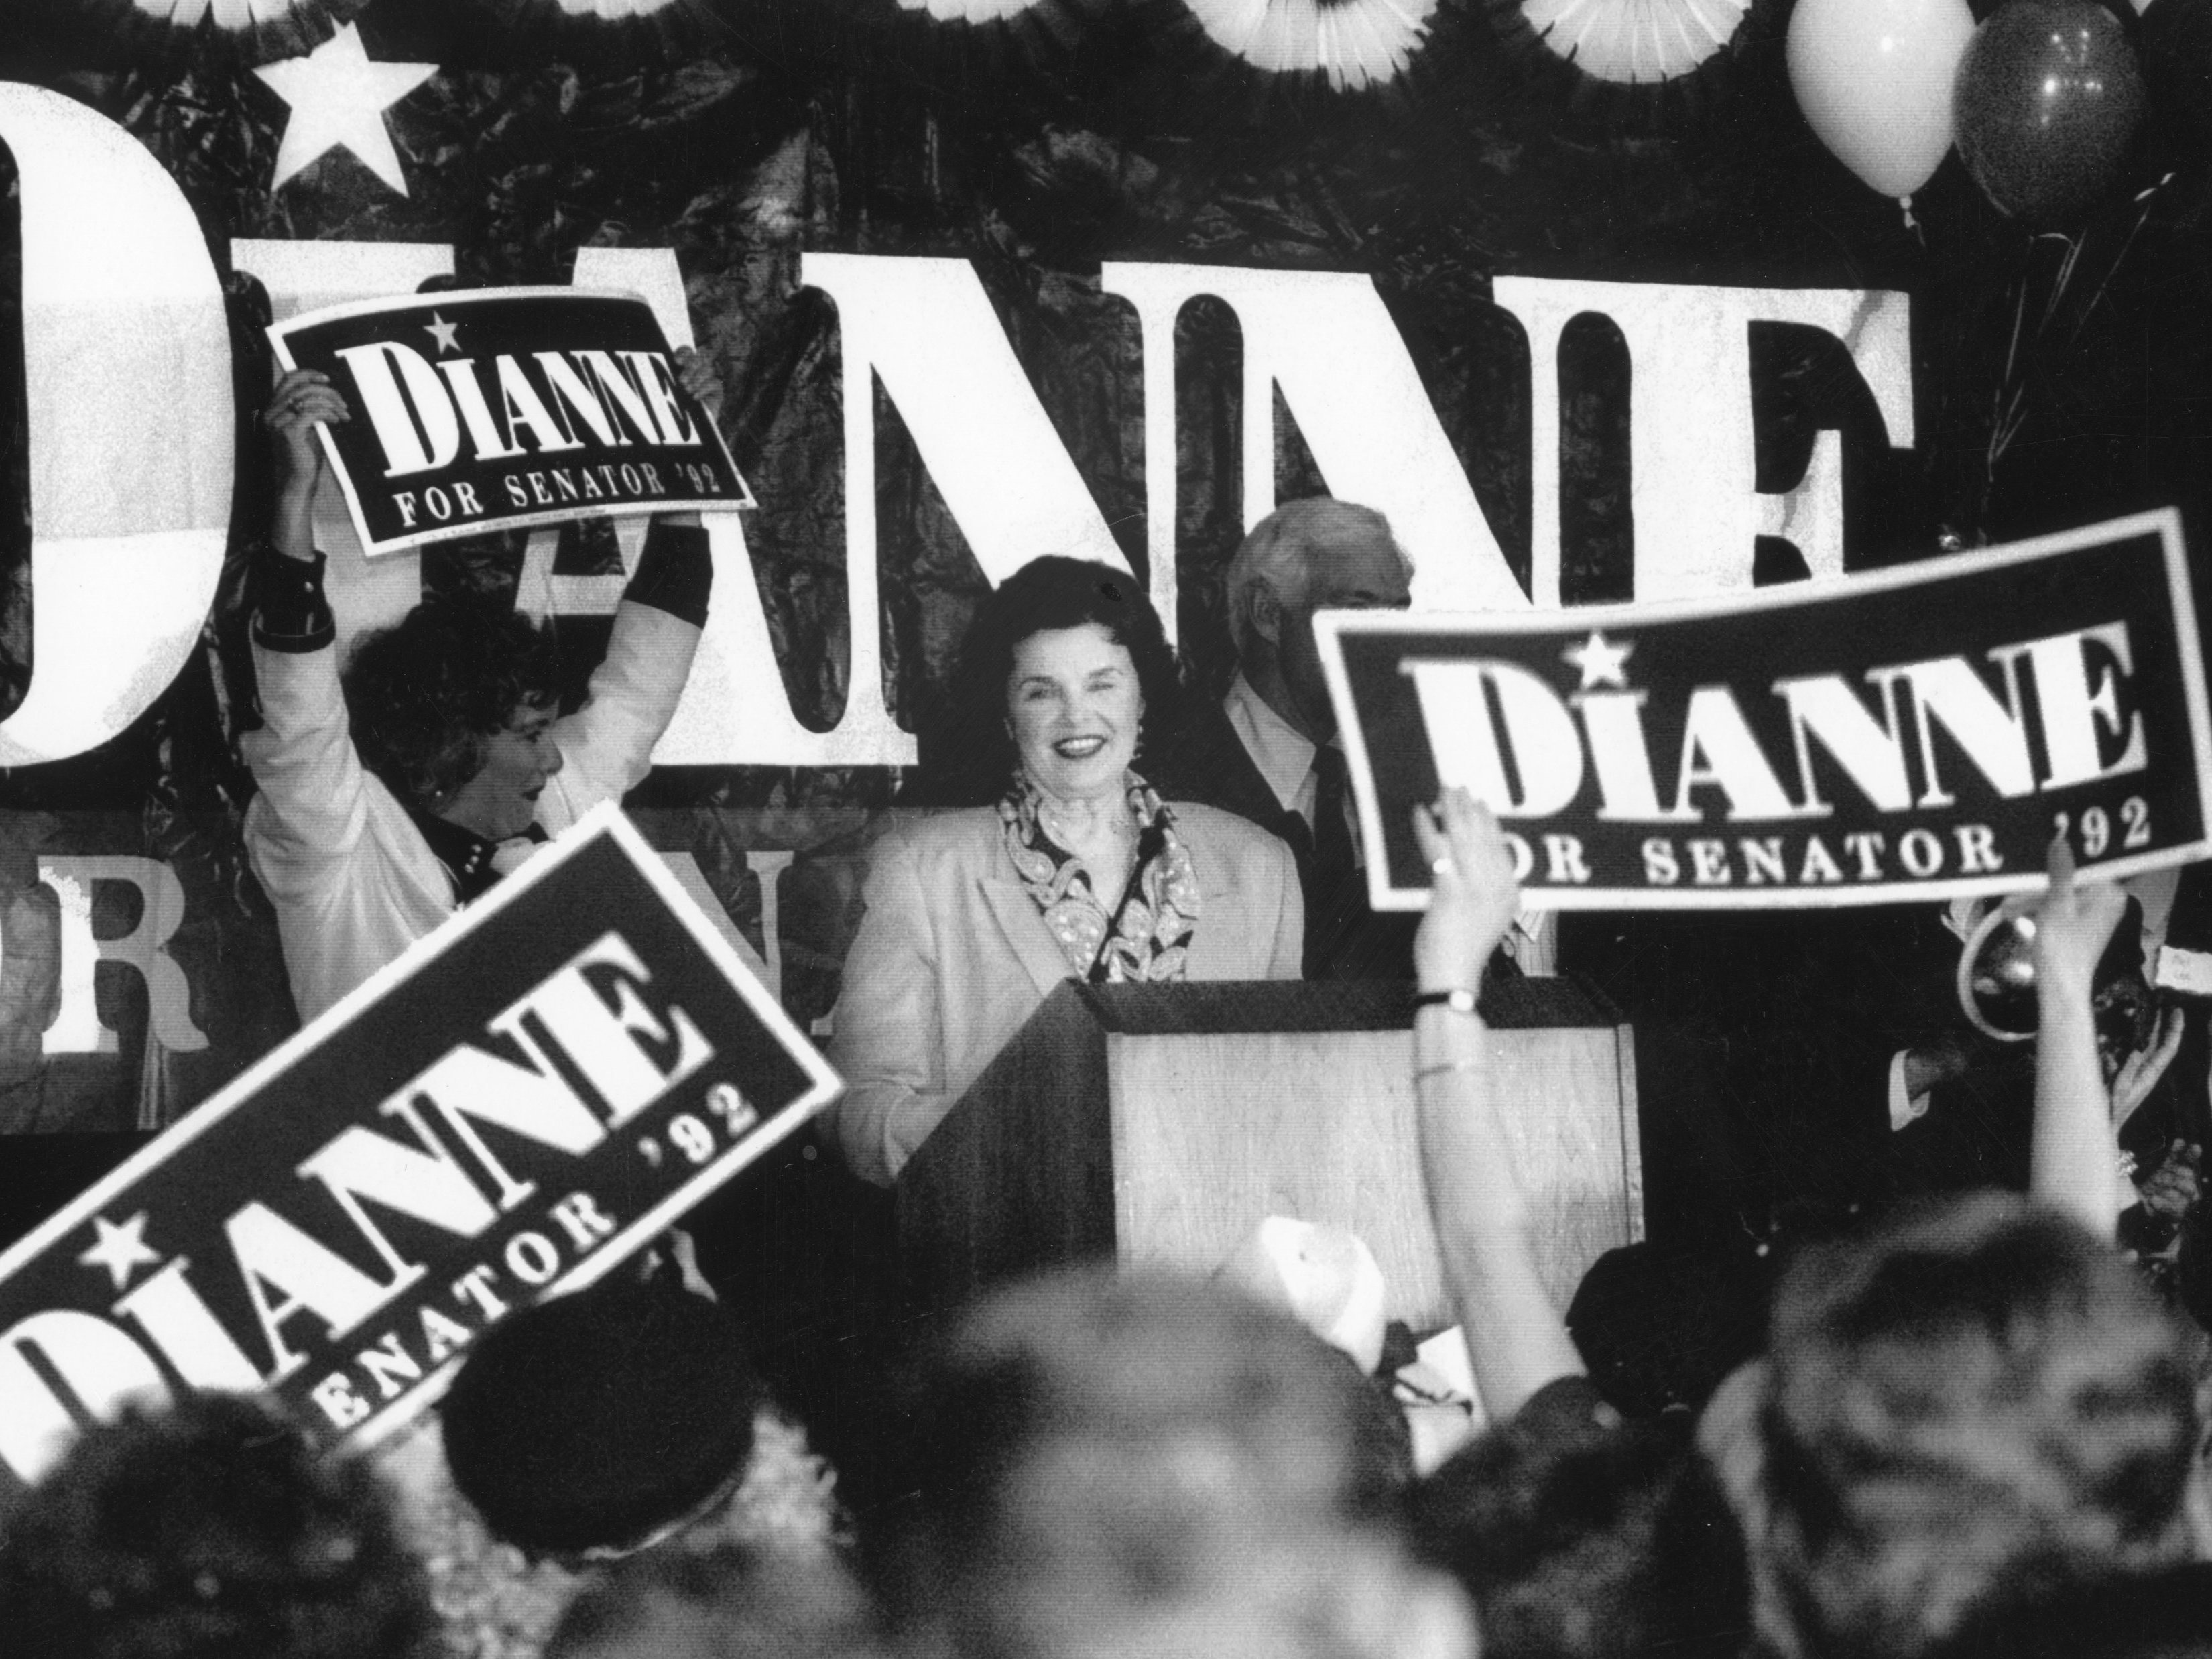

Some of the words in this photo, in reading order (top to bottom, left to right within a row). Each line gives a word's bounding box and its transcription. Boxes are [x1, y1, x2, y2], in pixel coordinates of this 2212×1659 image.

[334, 341, 702, 478] DIANNE
[392, 481, 484, 528] FOR
[504, 462, 666, 508] SENATOR
[674, 461, 721, 495] '92
[1398, 619, 2148, 822] DIANNE
[1501, 833, 1592, 884] OR
[1640, 823, 2004, 885] SENATOR
[2053, 795, 2152, 859] '92
[310, 1191, 619, 1430] ENATOR
[637, 1080, 759, 1168] '92
